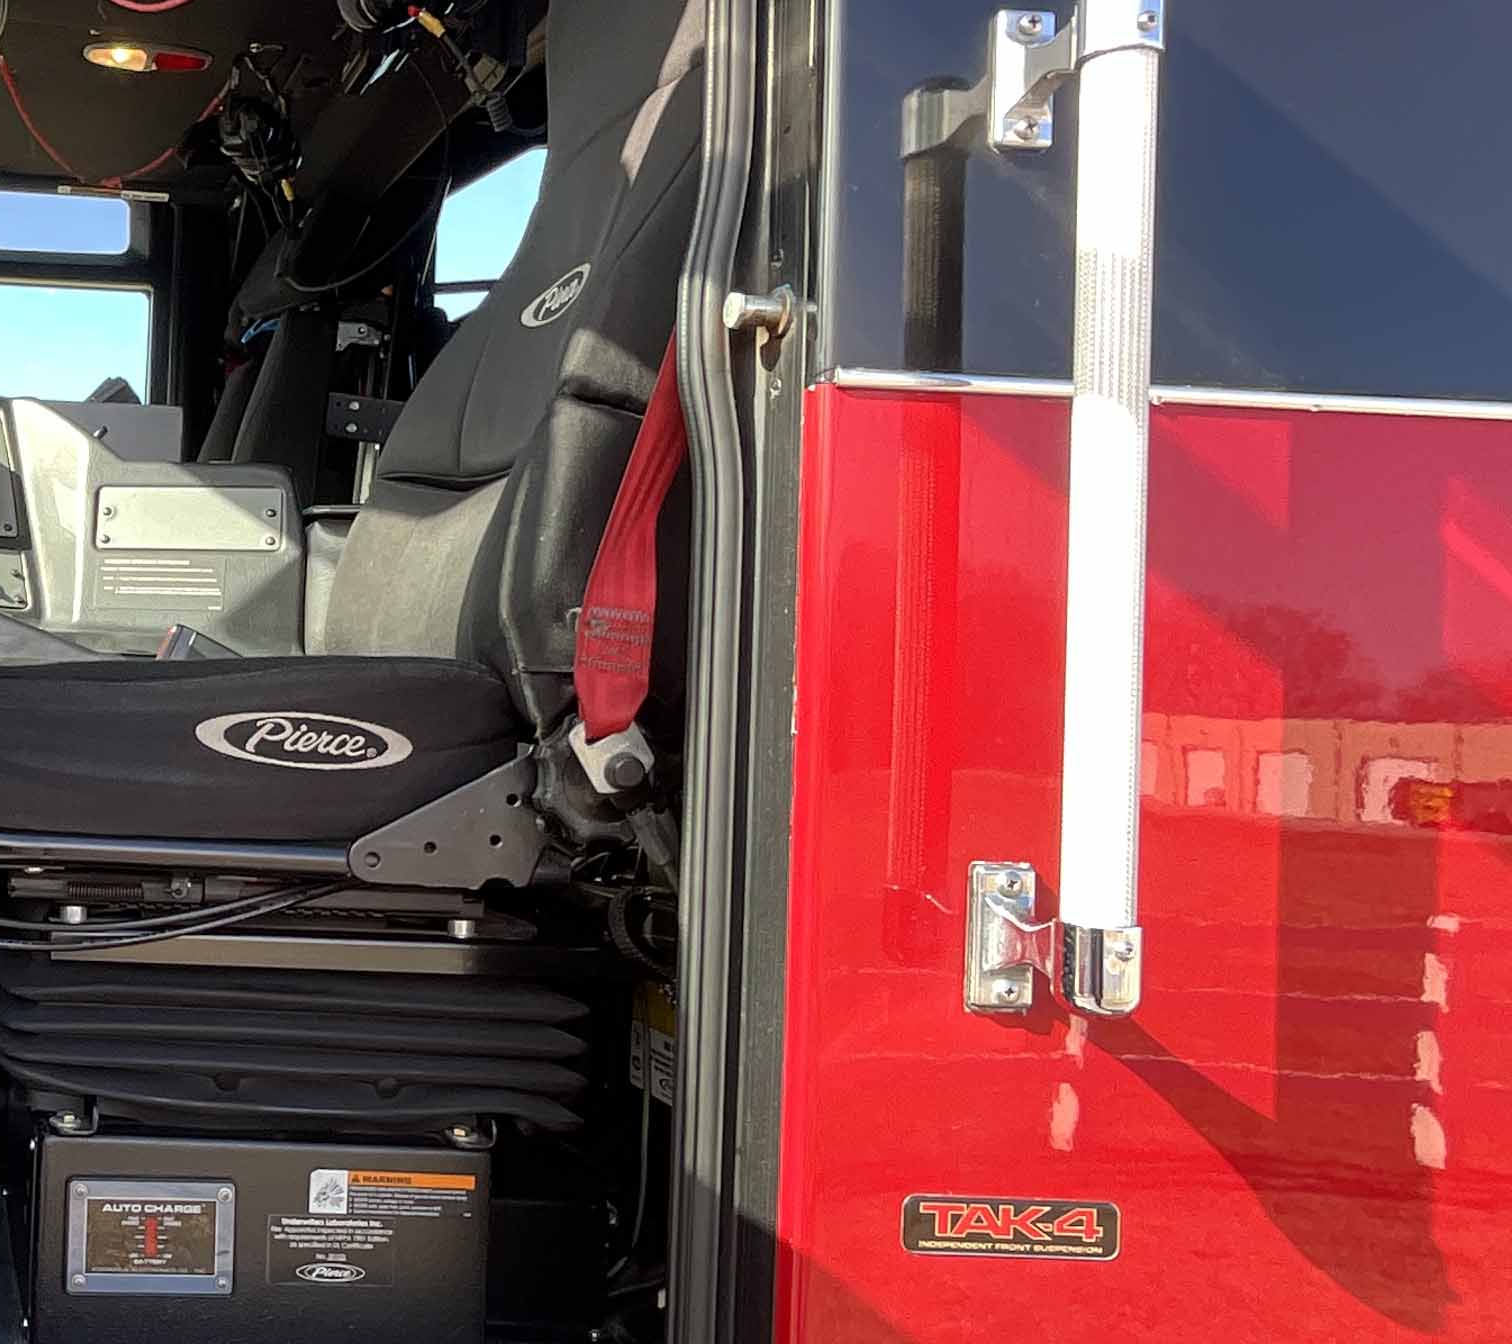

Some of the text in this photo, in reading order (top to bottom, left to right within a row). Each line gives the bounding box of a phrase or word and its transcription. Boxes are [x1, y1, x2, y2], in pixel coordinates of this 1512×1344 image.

[244, 717, 367, 757] Pierce
[101, 1203, 201, 1215] AUTO CHARGE
[918, 1201, 1105, 1243] TAK-4
[918, 1239, 1104, 1255] INDEPENDENT FRONT SUSPENSION
